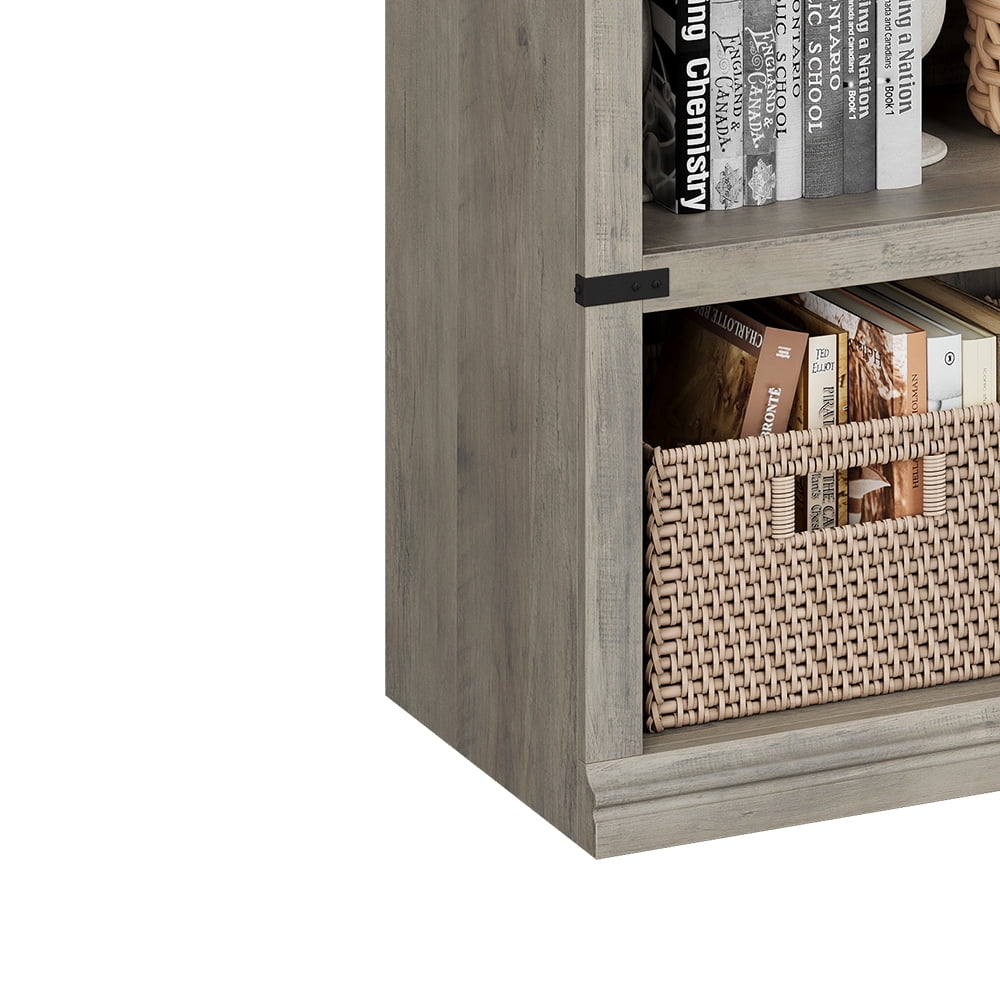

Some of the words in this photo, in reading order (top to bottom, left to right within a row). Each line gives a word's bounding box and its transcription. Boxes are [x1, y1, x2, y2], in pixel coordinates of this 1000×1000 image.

[885, 17, 893, 31] and
[858, 37, 869, 49] a
[885, 32, 893, 69] Canadians
[899, 33, 912, 45] a
[808, 41, 822, 134] SCHOOL
[858, 53, 872, 120] Nation
[898, 48, 915, 114] Nation
[776, 51, 787, 138] SCHOOL
[848, 90, 857, 113] Book
[885, 86, 895, 109] Book
[681, 57, 709, 210] Chemistry
[730, 121, 740, 132] &
[763, 117, 774, 129] &
[710, 308, 763, 348] CHARLOTTE
[815, 348, 830, 360] TED
[823, 473, 835, 502] THE
